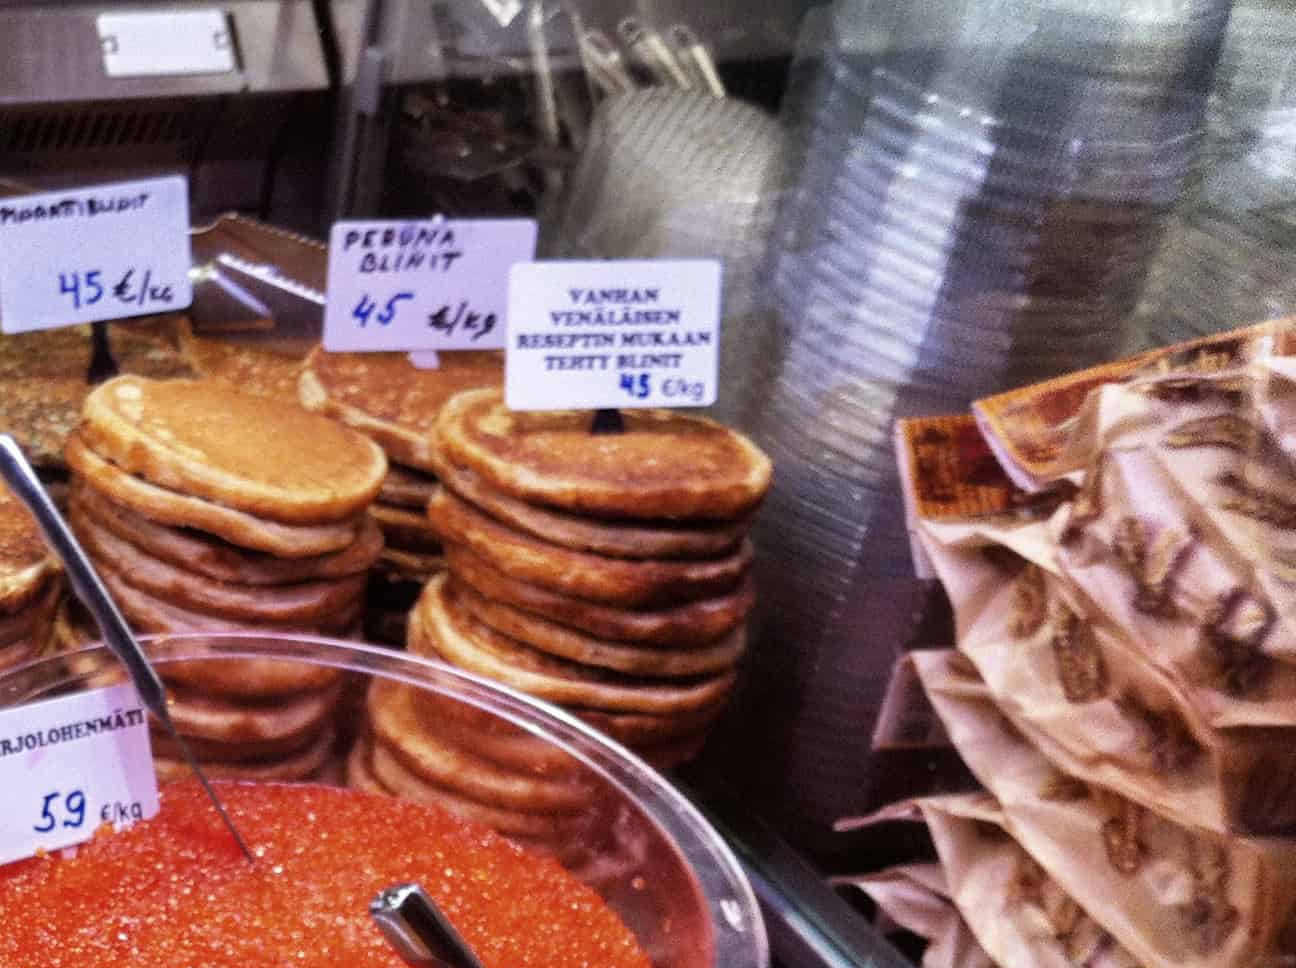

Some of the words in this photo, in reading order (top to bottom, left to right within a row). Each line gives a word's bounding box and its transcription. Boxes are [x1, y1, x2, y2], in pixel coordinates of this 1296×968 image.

[342, 228, 455, 250] PERUNA
[358, 251, 464, 273] BLINIT
[59, 271, 103, 310] 45
[569, 289, 660, 304] VANHAN
[352, 292, 415, 327] 45
[516, 333, 615, 349] RESEPTIN
[621, 332, 712, 347] MUKAAN
[617, 354, 683, 369] BLINIT
[620, 373, 651, 398] 45
[662, 379, 705, 401] €/kg
[34, 790, 86, 833] 59
